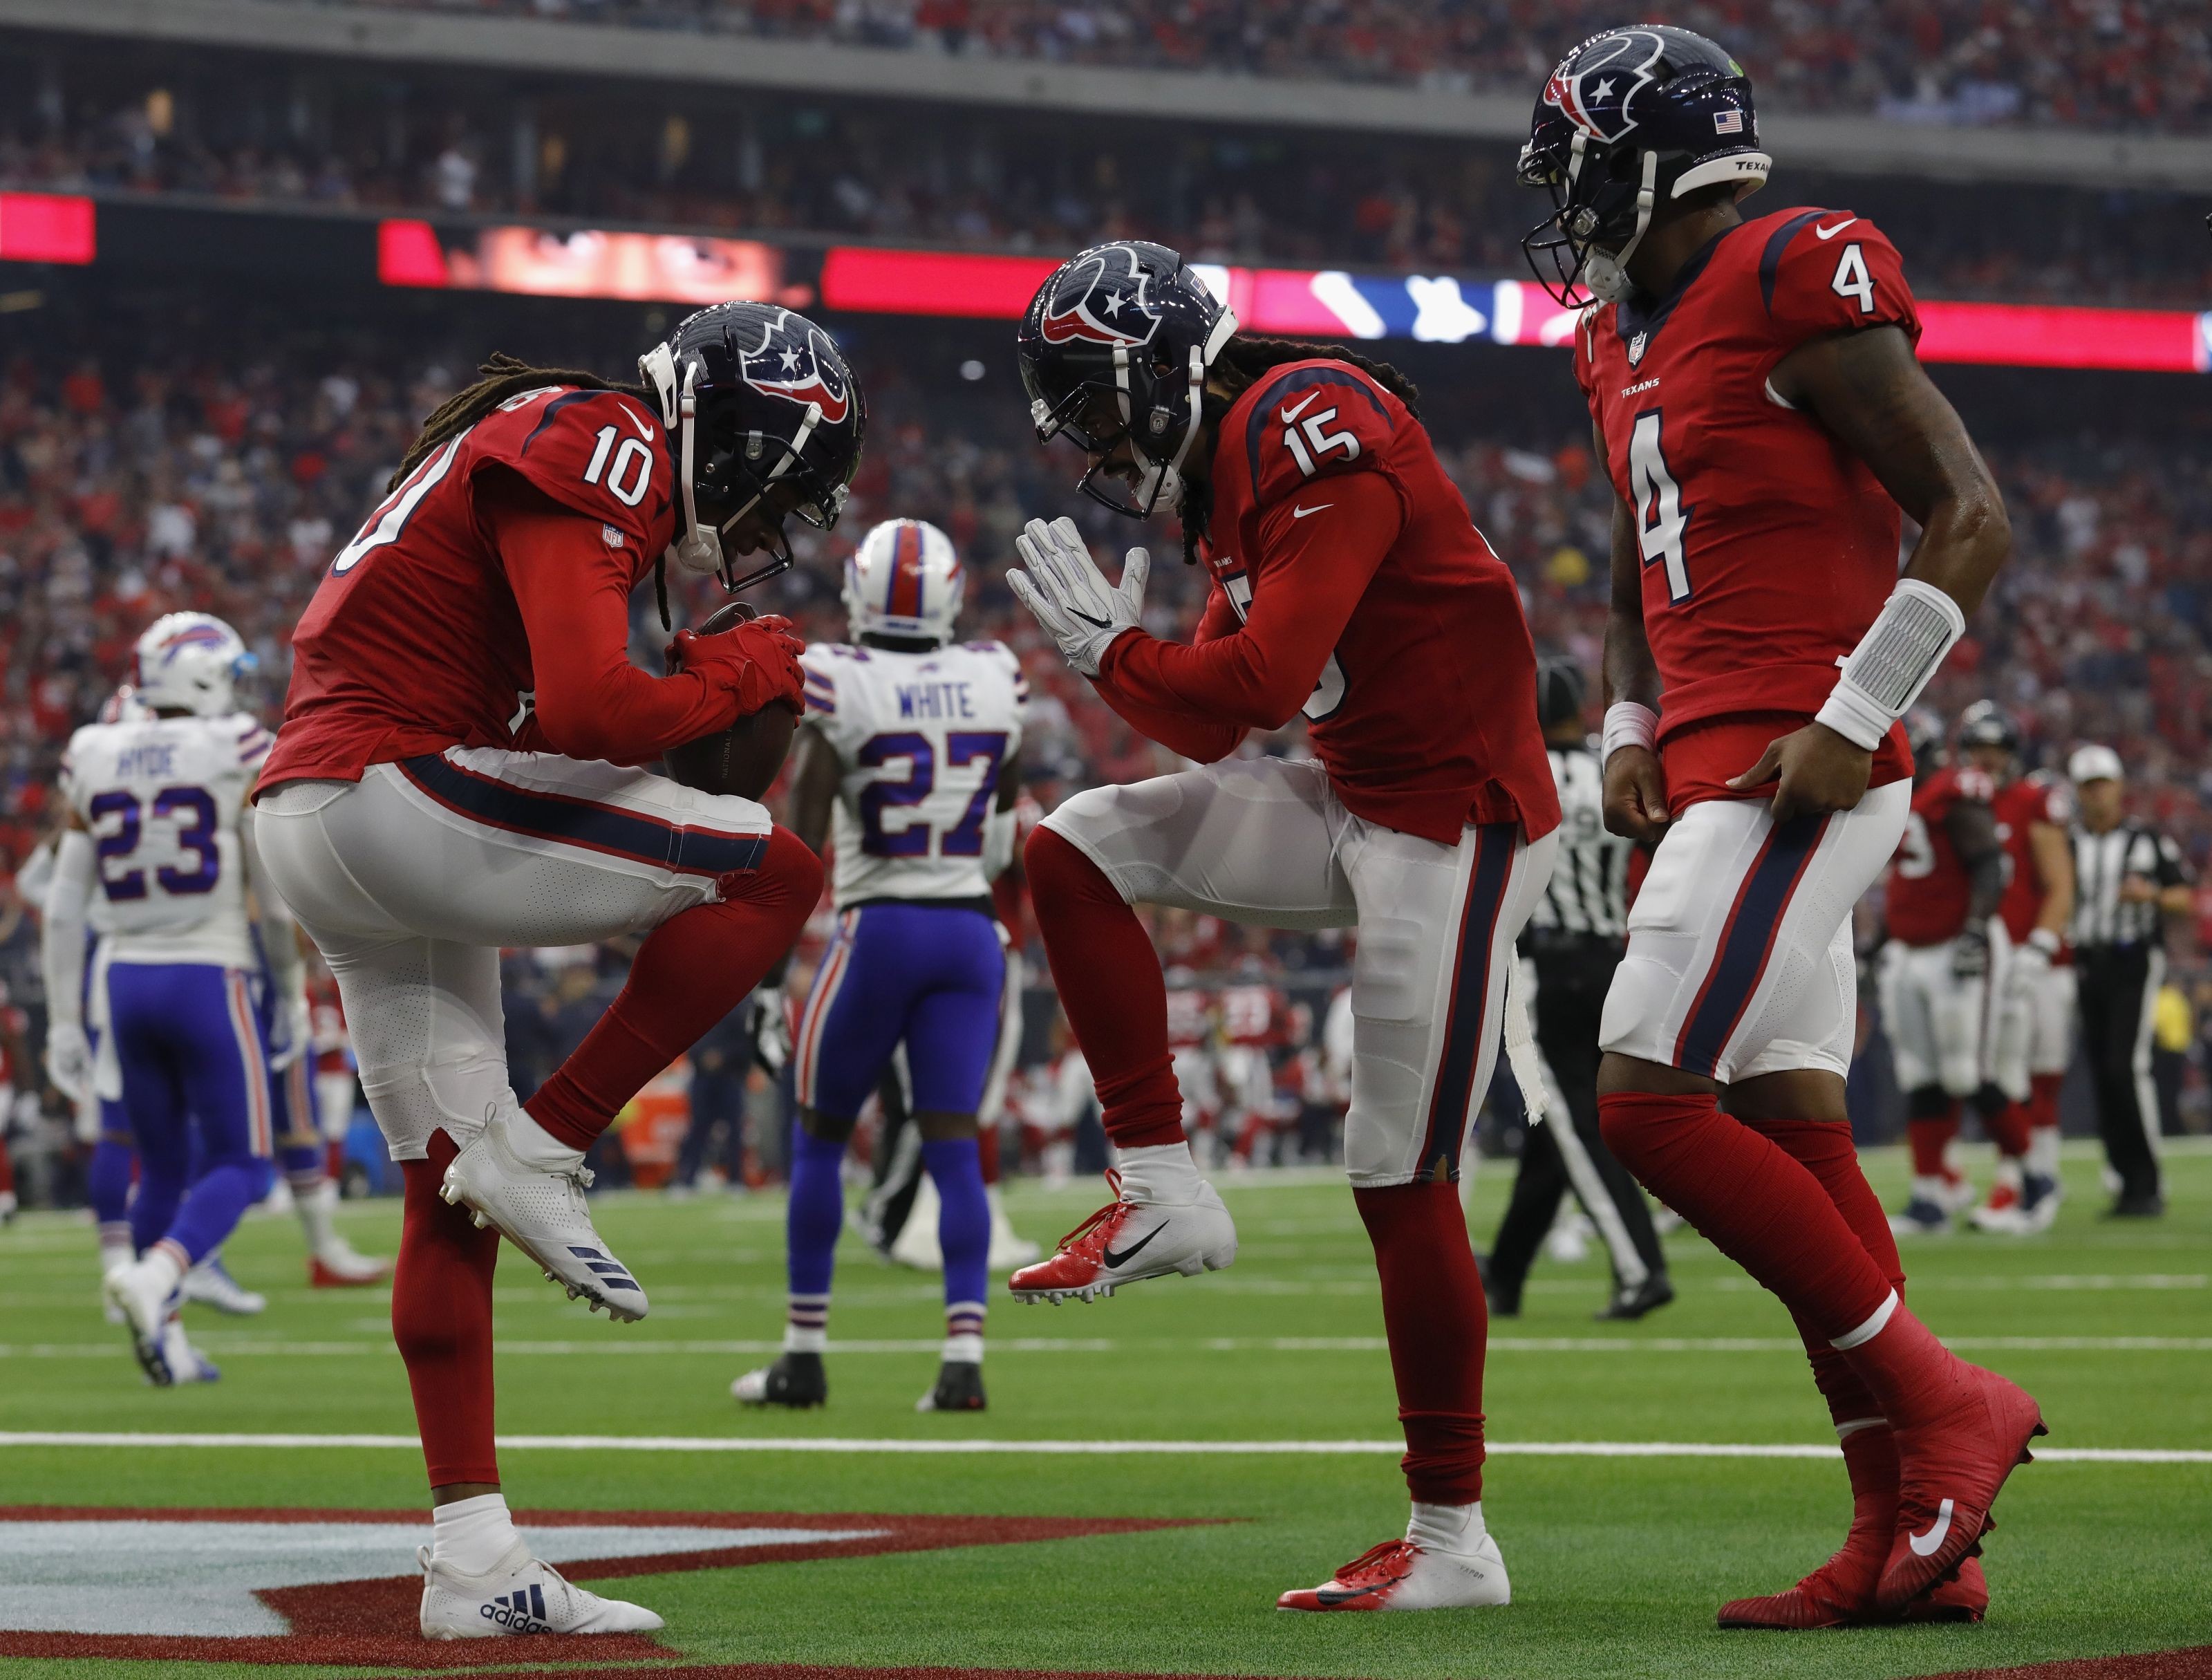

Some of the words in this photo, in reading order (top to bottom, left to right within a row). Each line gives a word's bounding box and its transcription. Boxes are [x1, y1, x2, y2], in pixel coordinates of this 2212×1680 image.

[1830, 242, 1877, 315] 4
[1621, 377, 1660, 399] TEXANS
[583, 424, 655, 508] 10
[1283, 406, 1360, 477] 15
[1628, 407, 1695, 607] 4
[896, 682, 976, 720] WHITE
[116, 743, 180, 778] HYDE
[857, 731, 1009, 858] 27
[90, 785, 220, 902] 23
